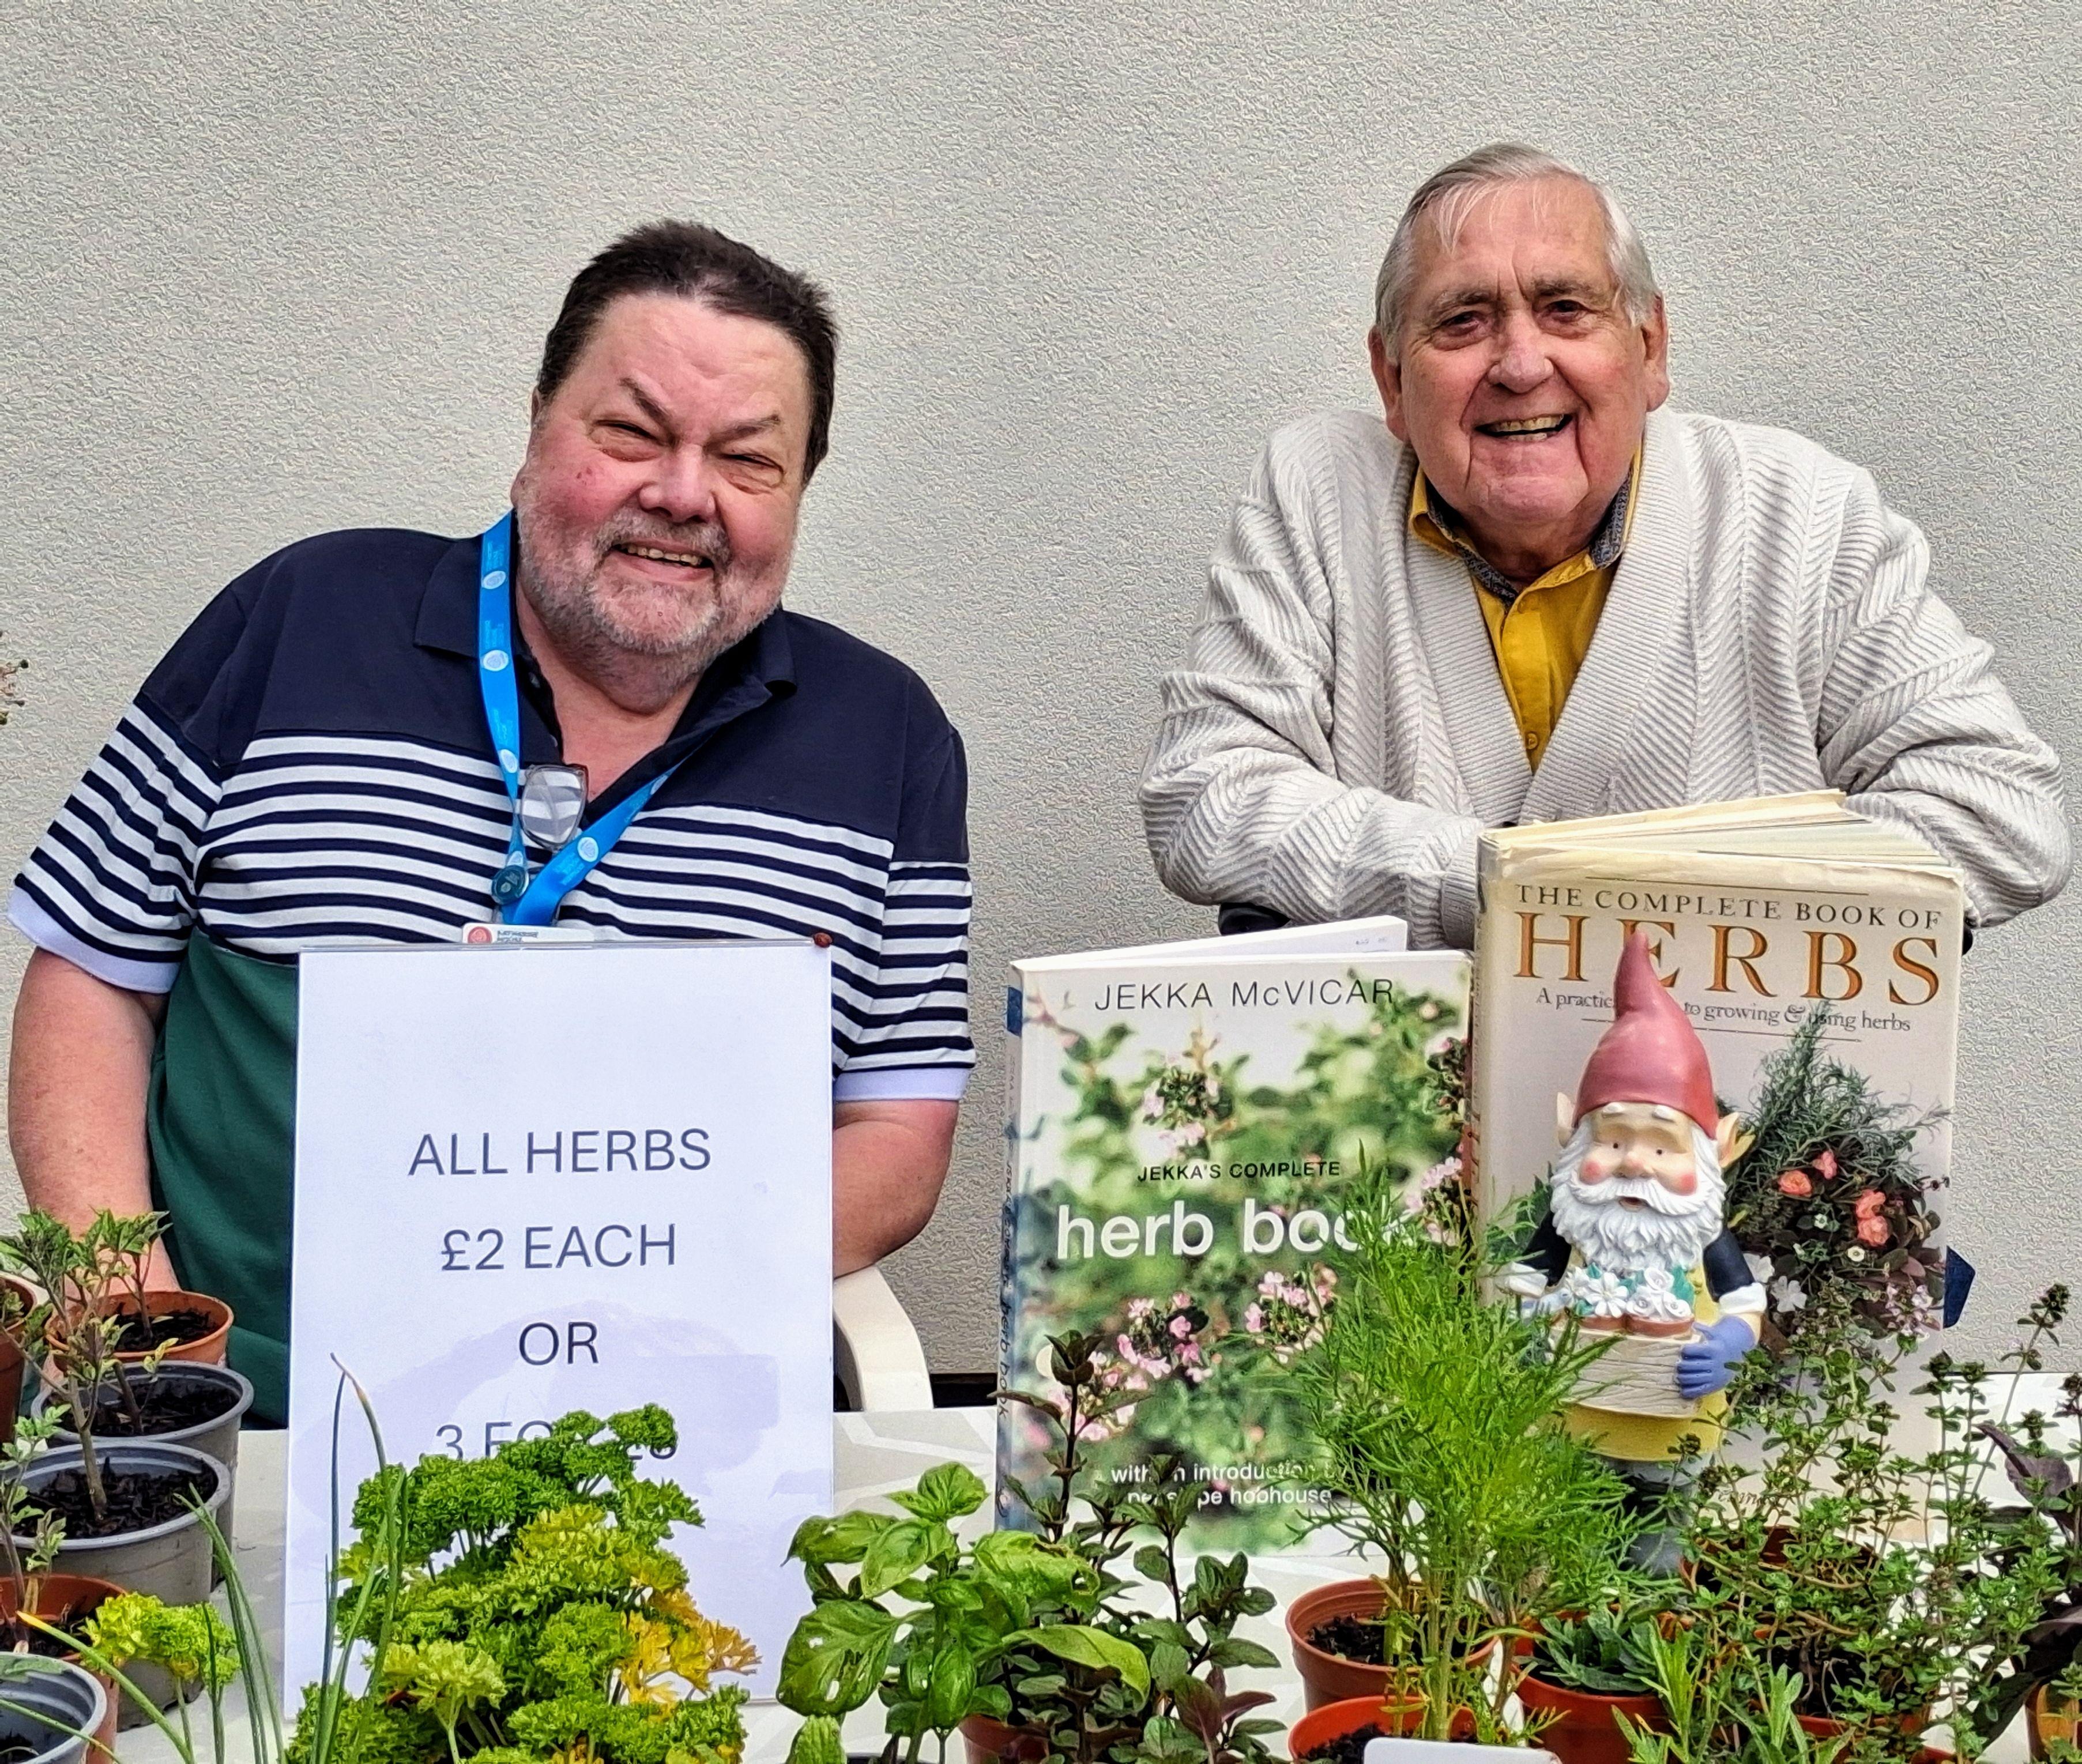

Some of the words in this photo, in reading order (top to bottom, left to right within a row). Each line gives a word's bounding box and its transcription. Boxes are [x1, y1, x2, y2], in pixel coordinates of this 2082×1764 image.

[1515, 884, 1582, 907] THE
[1595, 891, 1781, 920] COMPLETE
[1796, 902, 1885, 926] BOOK
[1899, 909, 1941, 929] OF
[1513, 911, 1939, 1005] HERBS
[1095, 982, 1213, 1011] JEKKA
[1232, 979, 1393, 1007] McVICAR
[1536, 987, 1552, 1004] A
[1556, 990, 1615, 1010] practic
[1684, 1002, 1700, 1015] to
[1704, 1003, 1780, 1026] growing
[1784, 1004, 1806, 1023] &
[1862, 1011, 1910, 1031] herbs
[408, 1133, 509, 1175] ALL
[527, 1128, 711, 1173] HERBS
[1138, 1164, 1221, 1182] JEKKA'S
[1229, 1161, 1341, 1178] COMPLETE
[441, 1228, 505, 1271] £2
[525, 1223, 676, 1269] EACH
[1057, 1200, 1213, 1260] herb
[519, 1321, 599, 1366] OR
[436, 1424, 463, 1460] 3
[1230, 1486, 1332, 1505] hobhouse
